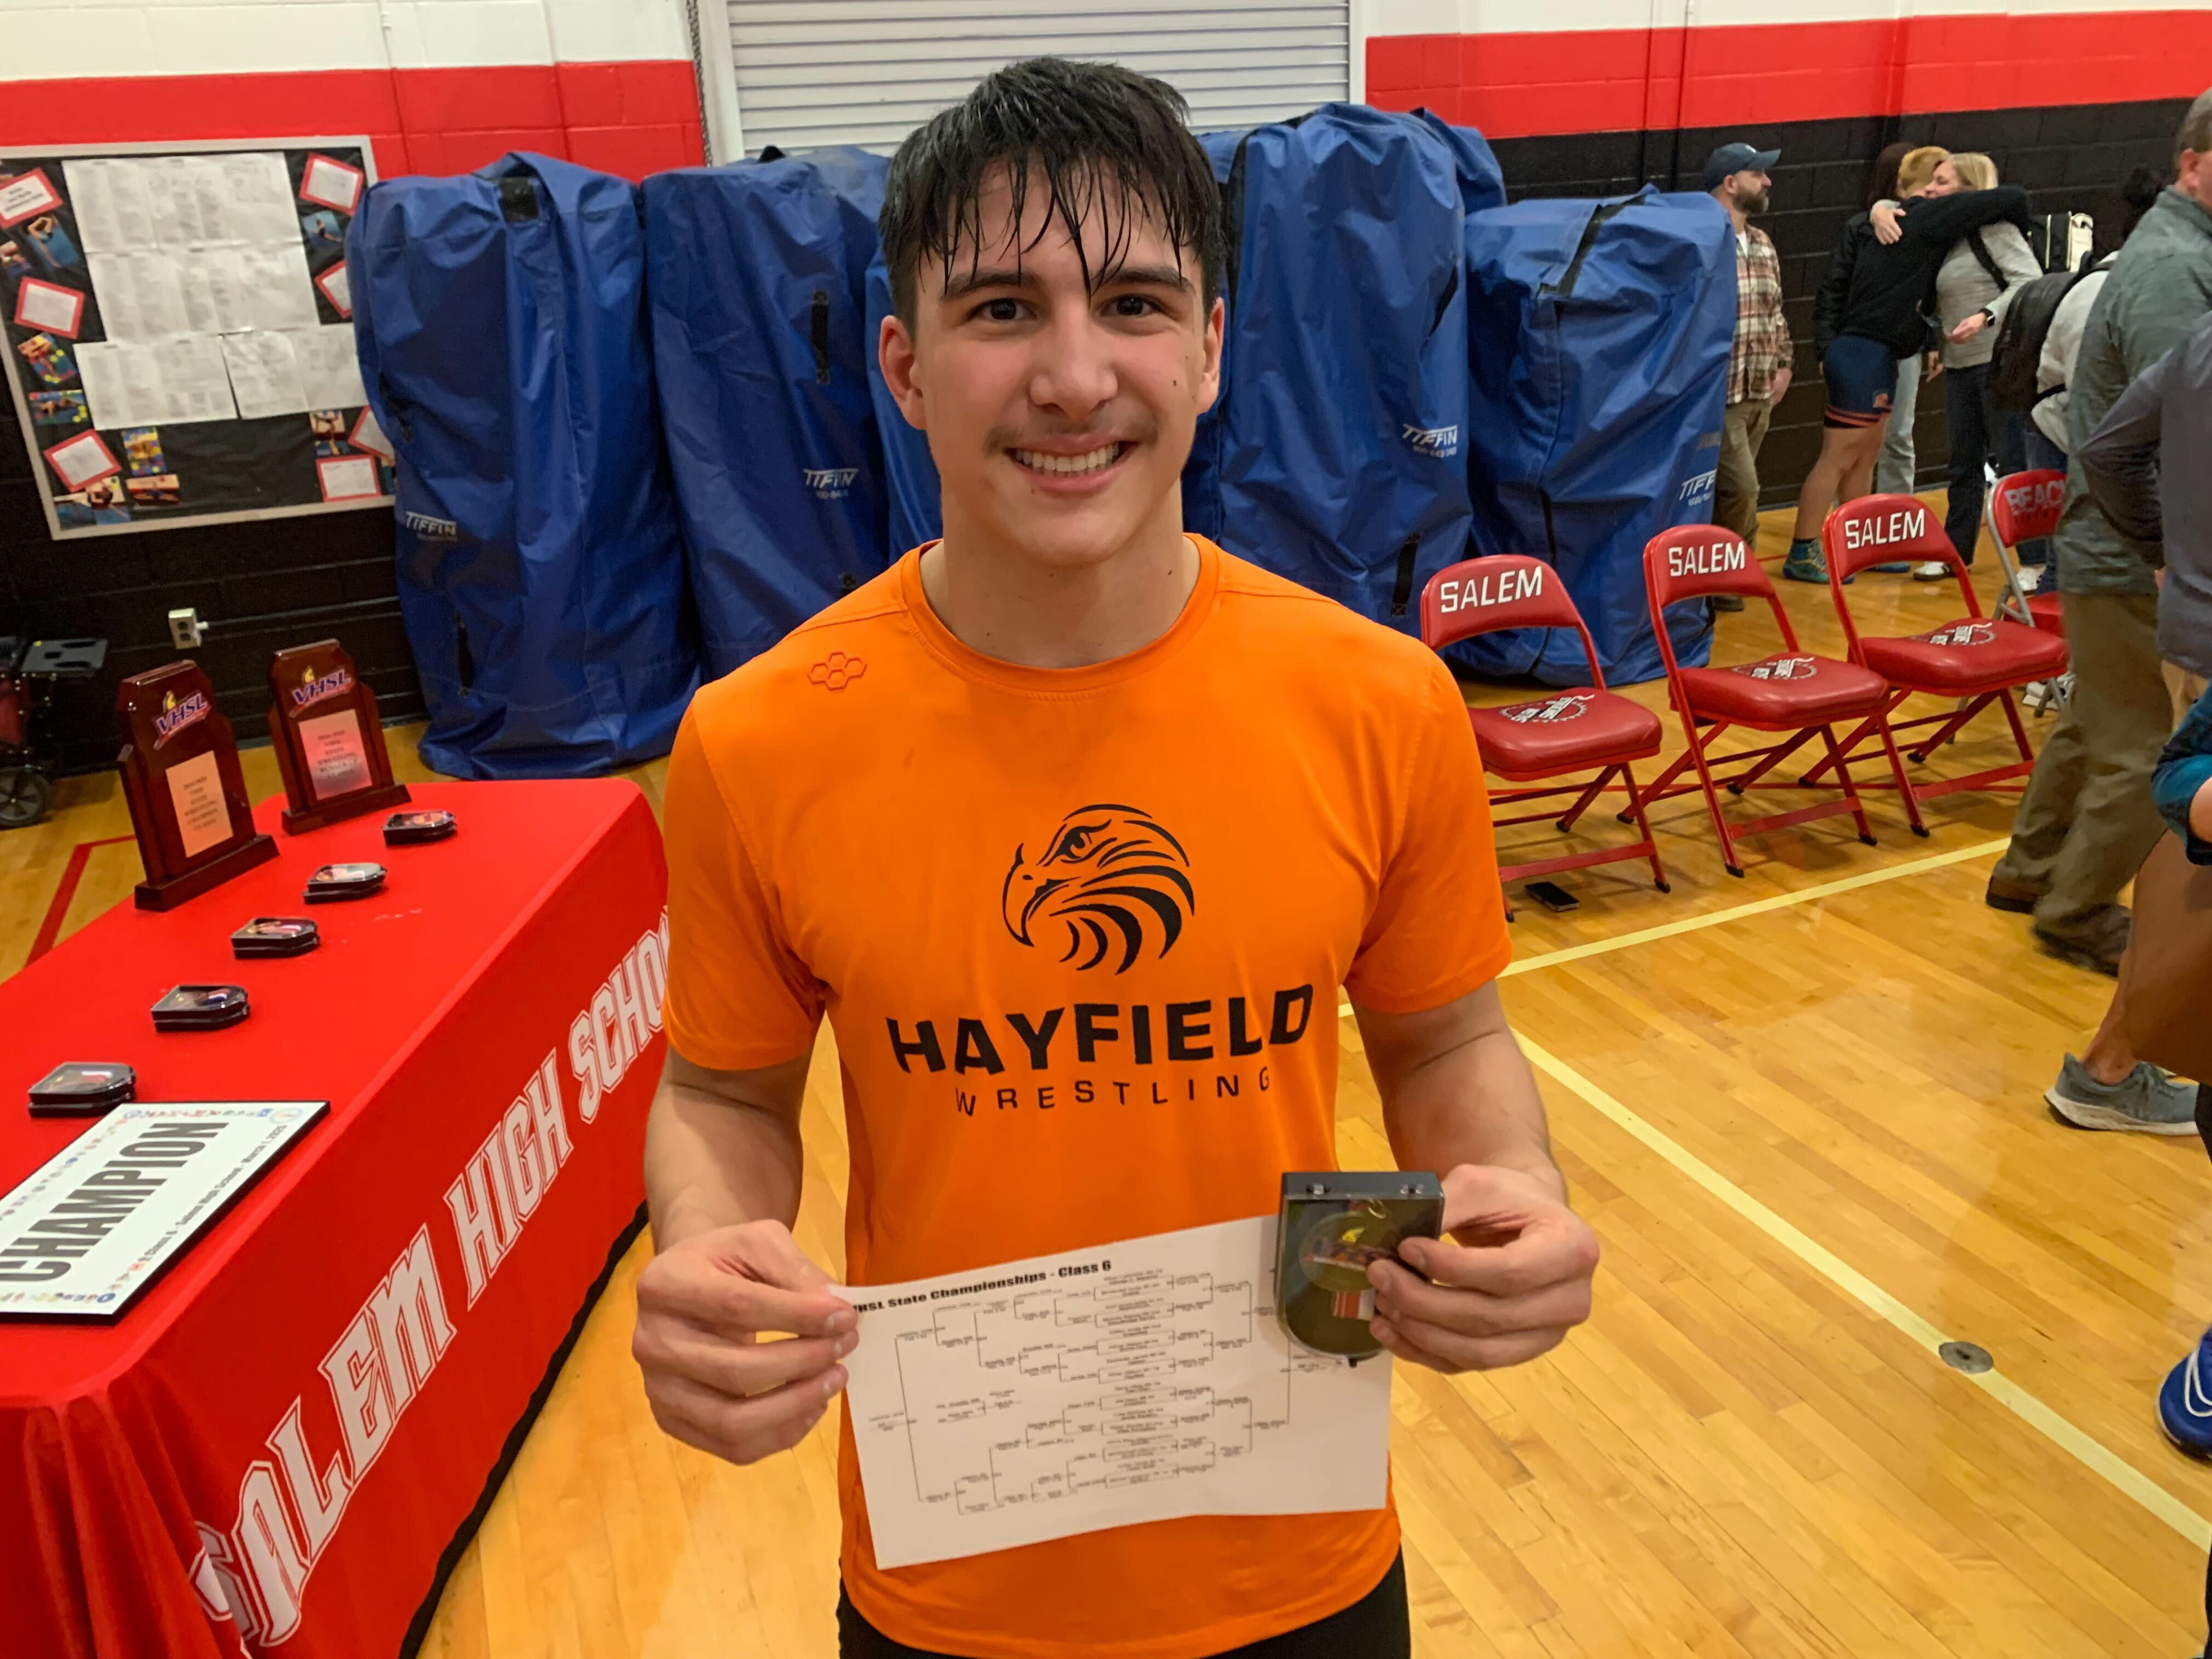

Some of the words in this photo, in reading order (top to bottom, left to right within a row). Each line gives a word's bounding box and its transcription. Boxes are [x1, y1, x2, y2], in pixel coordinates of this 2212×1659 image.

[1403, 423, 1458, 447] TIFFIN
[1679, 468, 1718, 501] TIFF
[2005, 480, 2065, 515] BEAC
[406, 510, 457, 536] TIFFIN
[1844, 508, 1925, 550] SALEM
[1668, 541, 1746, 577] SALEM
[1439, 565, 1543, 614] SALEM
[292, 669, 351, 705] VHSL
[156, 693, 208, 735] VHSL
[885, 983, 1314, 1076] HAYFIELD
[443, 1046, 574, 1311] HIGH
[568, 905, 669, 1125] SCHO
[954, 1066, 1270, 1117] WRESTLING
[0, 1123, 229, 1282] CHAMPION
[888, 1295, 927, 1308] State
[931, 1270, 1047, 1300] Championships
[1059, 1263, 1099, 1278] Class
[1102, 1260, 1112, 1272] 6
